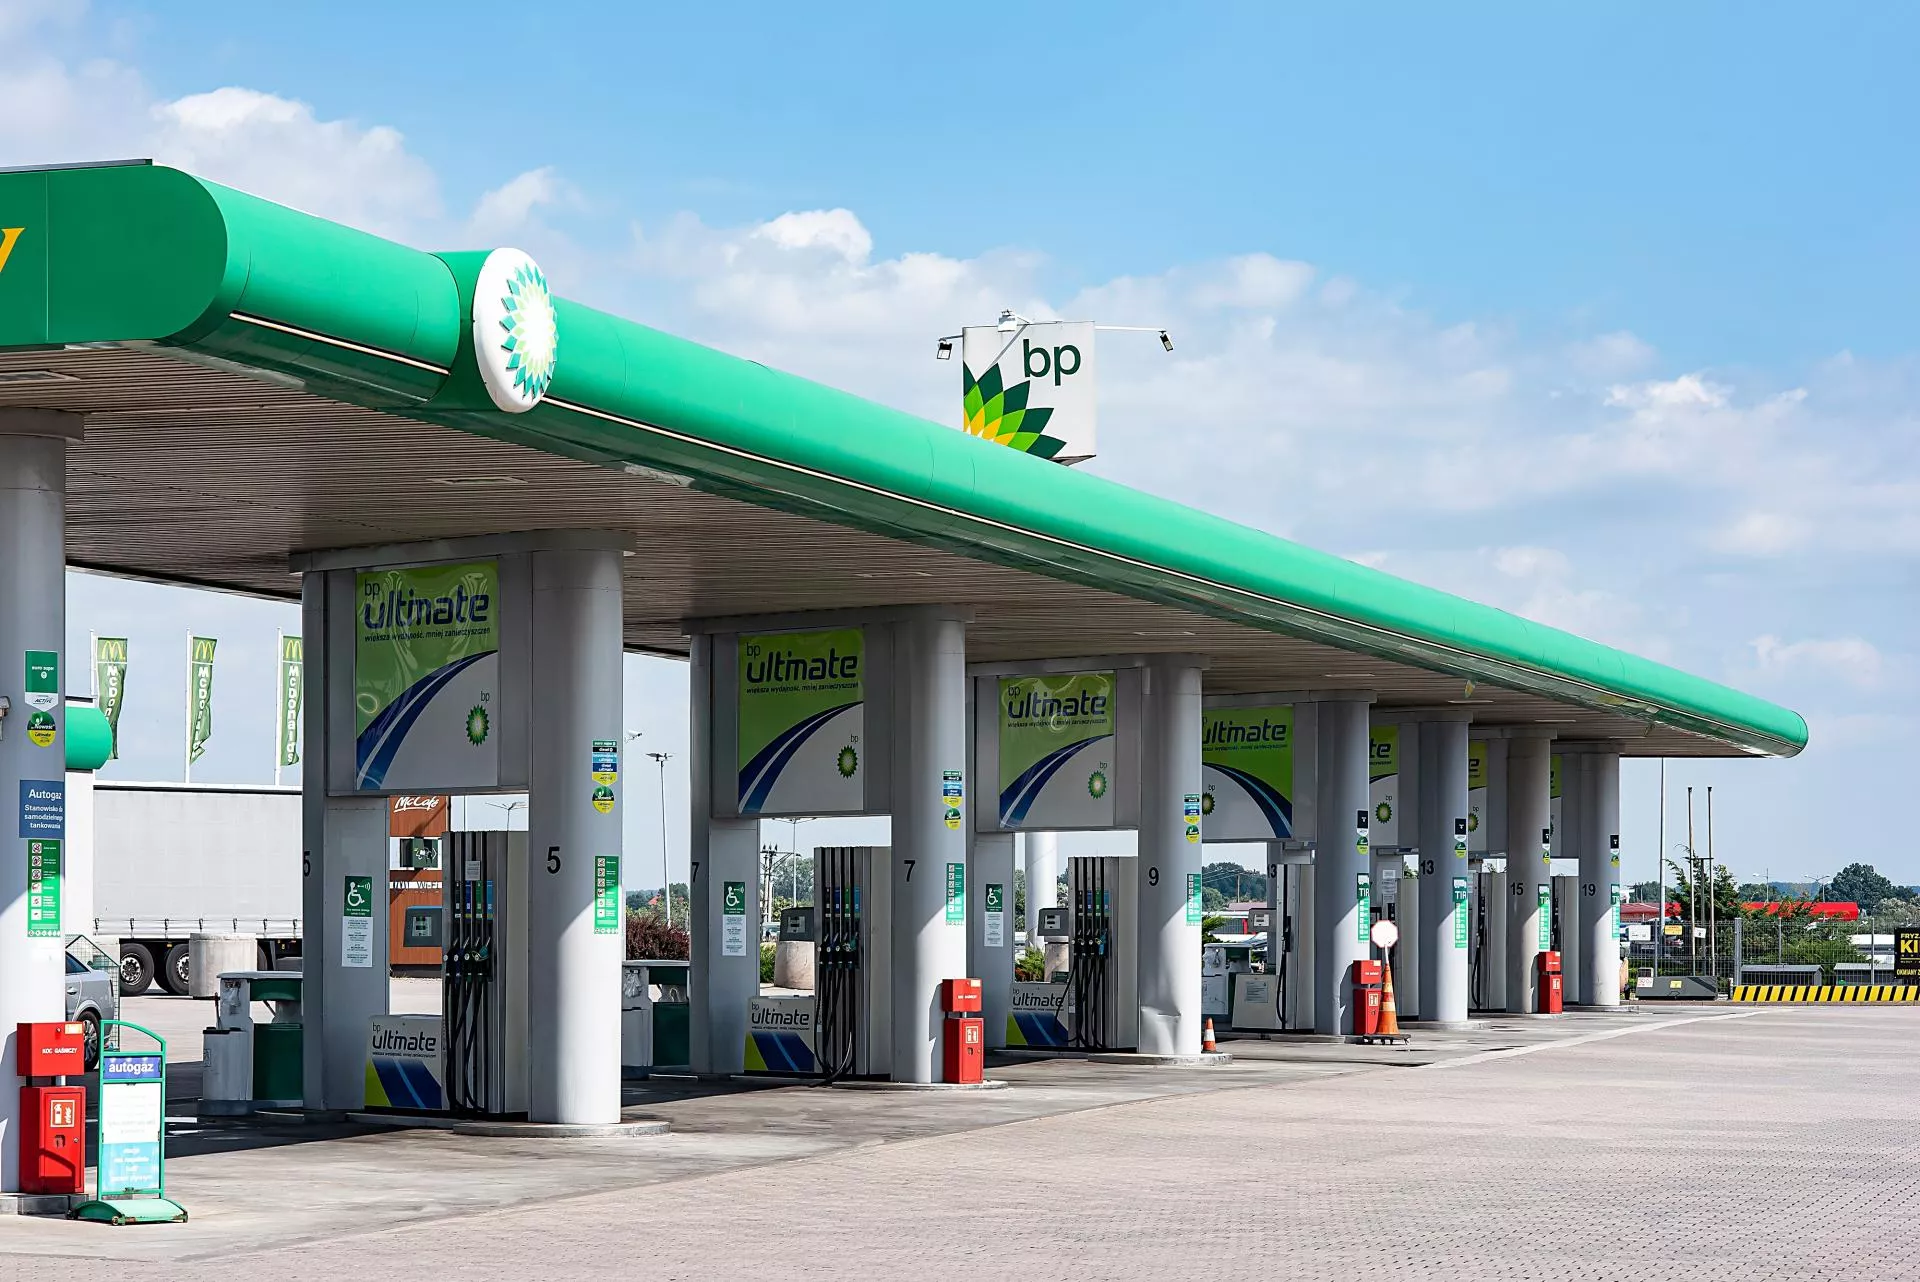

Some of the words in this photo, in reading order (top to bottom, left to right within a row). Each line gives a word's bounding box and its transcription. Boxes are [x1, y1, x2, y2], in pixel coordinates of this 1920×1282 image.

[1023, 338, 1081, 386] bp
[364, 579, 381, 598] bp
[364, 585, 489, 629] ultimate
[746, 642, 760, 658] bp
[746, 648, 858, 683] ultimate
[480, 690, 490, 703] bp
[1008, 685, 1020, 699] bp
[1008, 689, 1107, 719] ultimate
[850, 734, 859, 743] bp
[1100, 761, 1108, 770] bp
[28, 789, 62, 801] Autogaz
[24, 804, 58, 812] Stanowisko
[547, 846, 561, 874] 5
[691, 862, 700, 882] 7
[904, 860, 916, 882] 7
[1421, 860, 1435, 875] 13
[1148, 867, 1160, 887] 9
[1358, 888, 1370, 897] TIR
[1454, 891, 1467, 900] TIR
[1510, 883, 1524, 896] 15
[1582, 884, 1596, 896] 19
[1012, 993, 1063, 1007] ultimate
[751, 1008, 810, 1025] ultimate
[372, 1021, 381, 1034] bp
[372, 1029, 436, 1051] ultimate
[108, 1062, 154, 1075] autogaz
